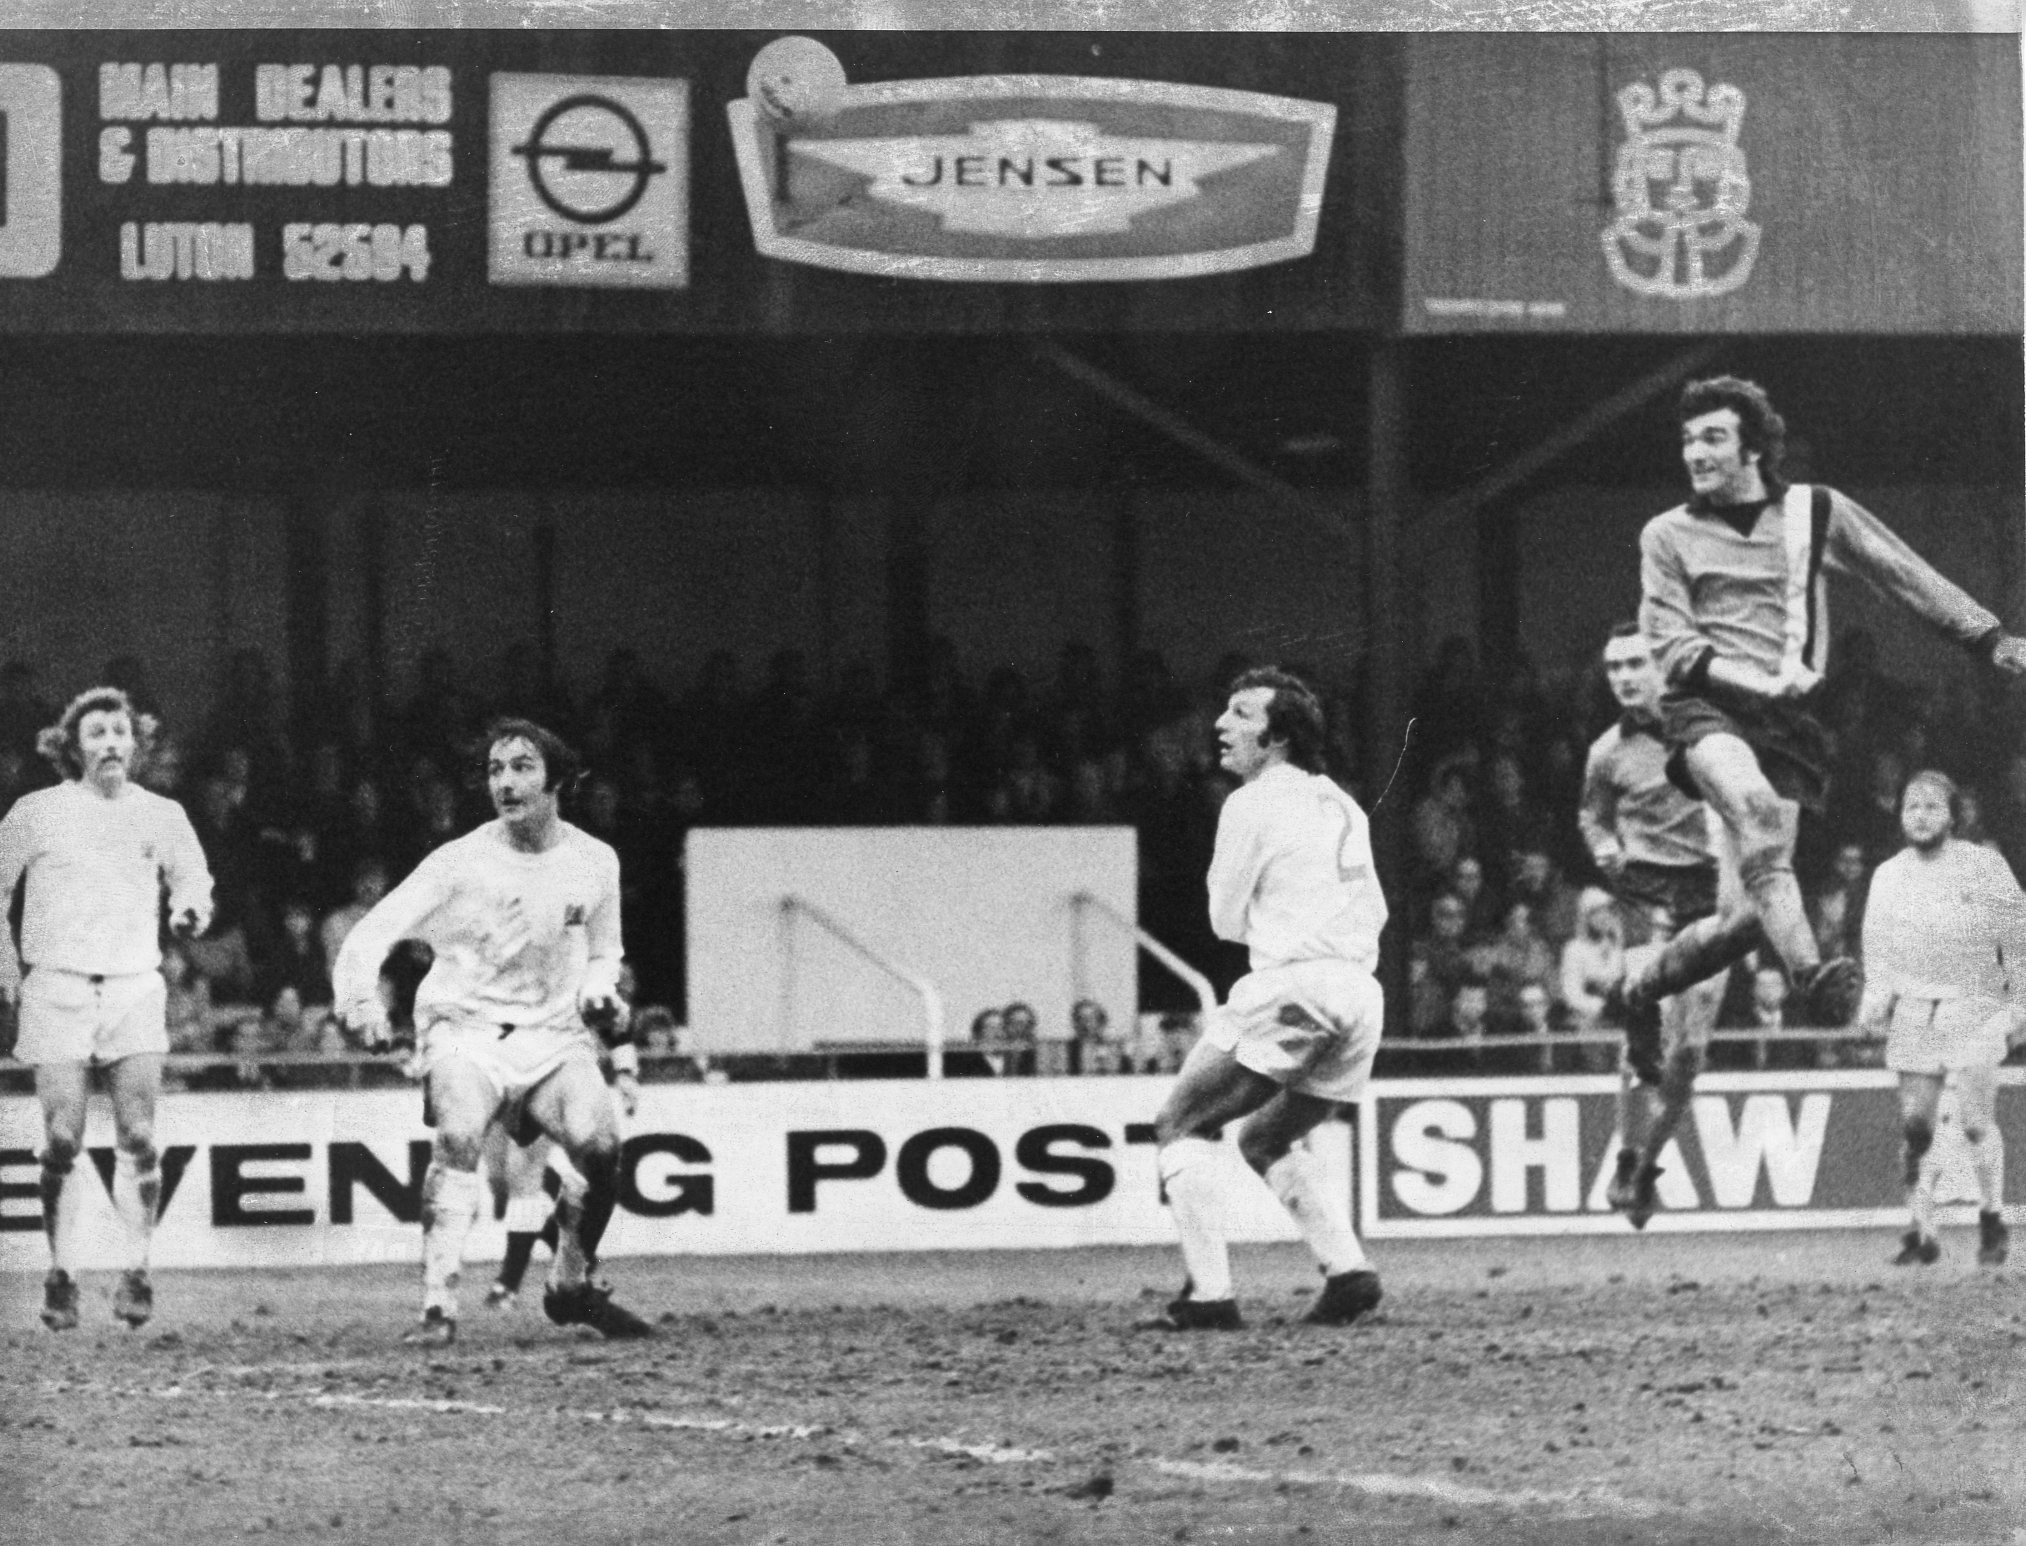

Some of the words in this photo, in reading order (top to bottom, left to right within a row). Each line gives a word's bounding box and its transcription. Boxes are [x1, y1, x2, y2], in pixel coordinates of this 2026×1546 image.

[901, 156, 1172, 187] JENSEN
[523, 231, 654, 261] OPEL
[1317, 793, 1368, 884] 2
[0, 1132, 714, 1232] VENG
[1391, 1093, 1832, 1215] SHAW
